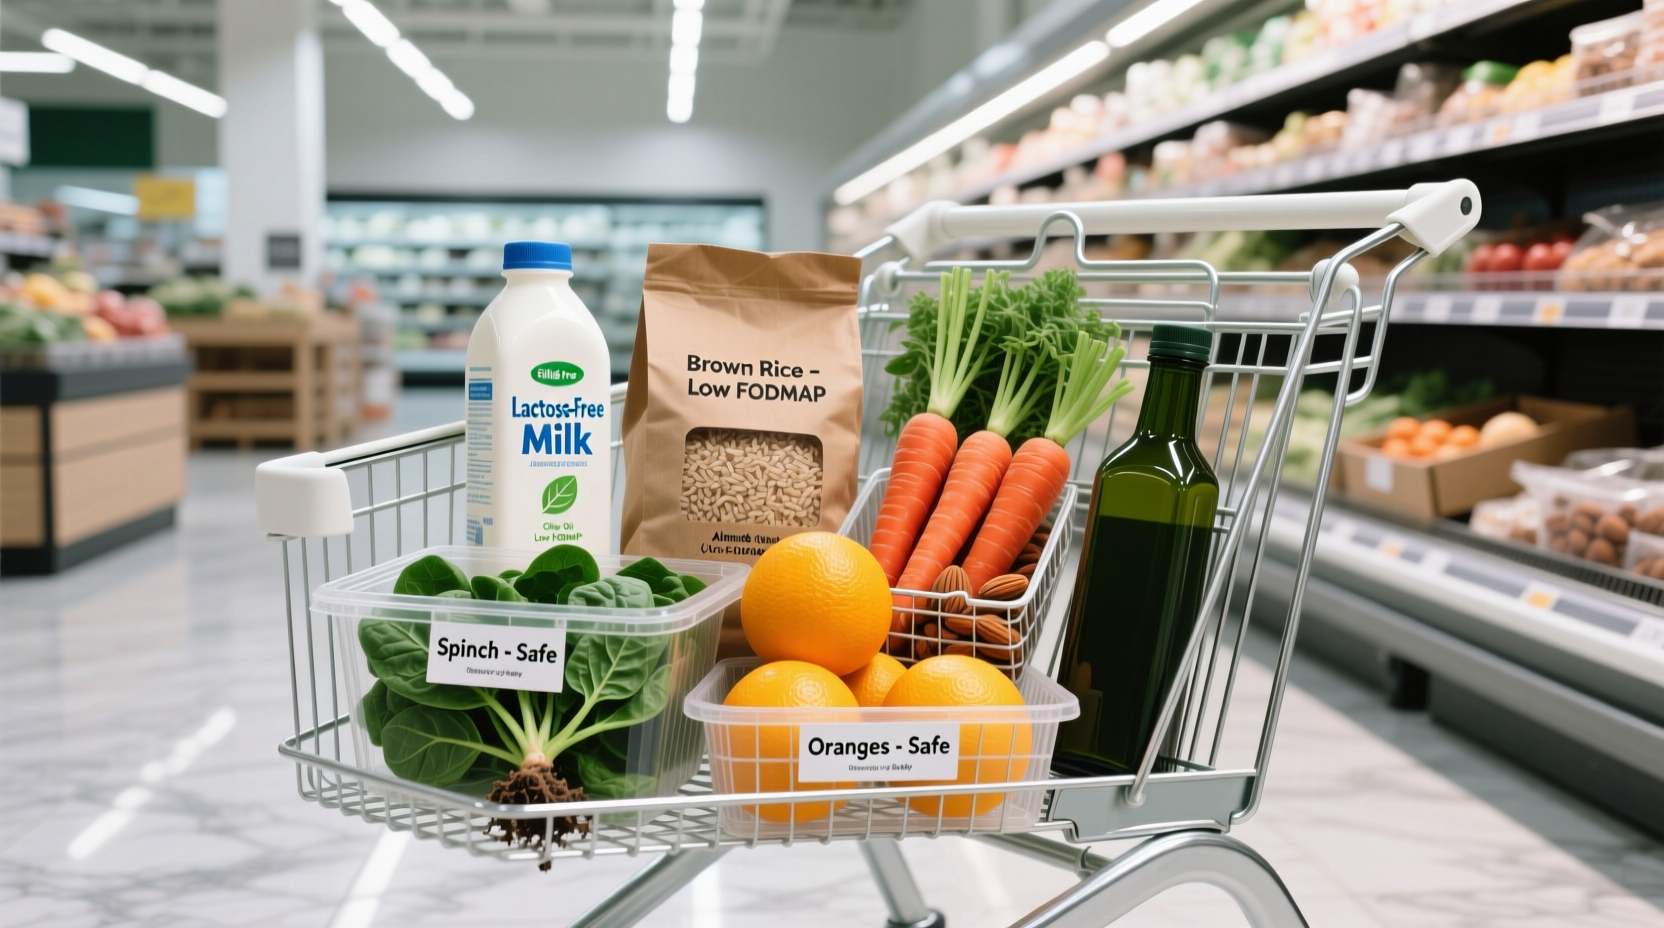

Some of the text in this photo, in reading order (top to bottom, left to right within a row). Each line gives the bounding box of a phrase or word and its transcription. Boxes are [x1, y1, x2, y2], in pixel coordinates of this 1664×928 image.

[687, 354, 753, 376] Brown
[759, 359, 803, 378] Rice
[688, 378, 826, 402] Low FODMAP
[522, 422, 593, 455] Milk
[437, 637, 499, 662] Spinch
[516, 643, 557, 663] Safe
[808, 737, 890, 760] Oranges
[908, 735, 950, 754] Safe
